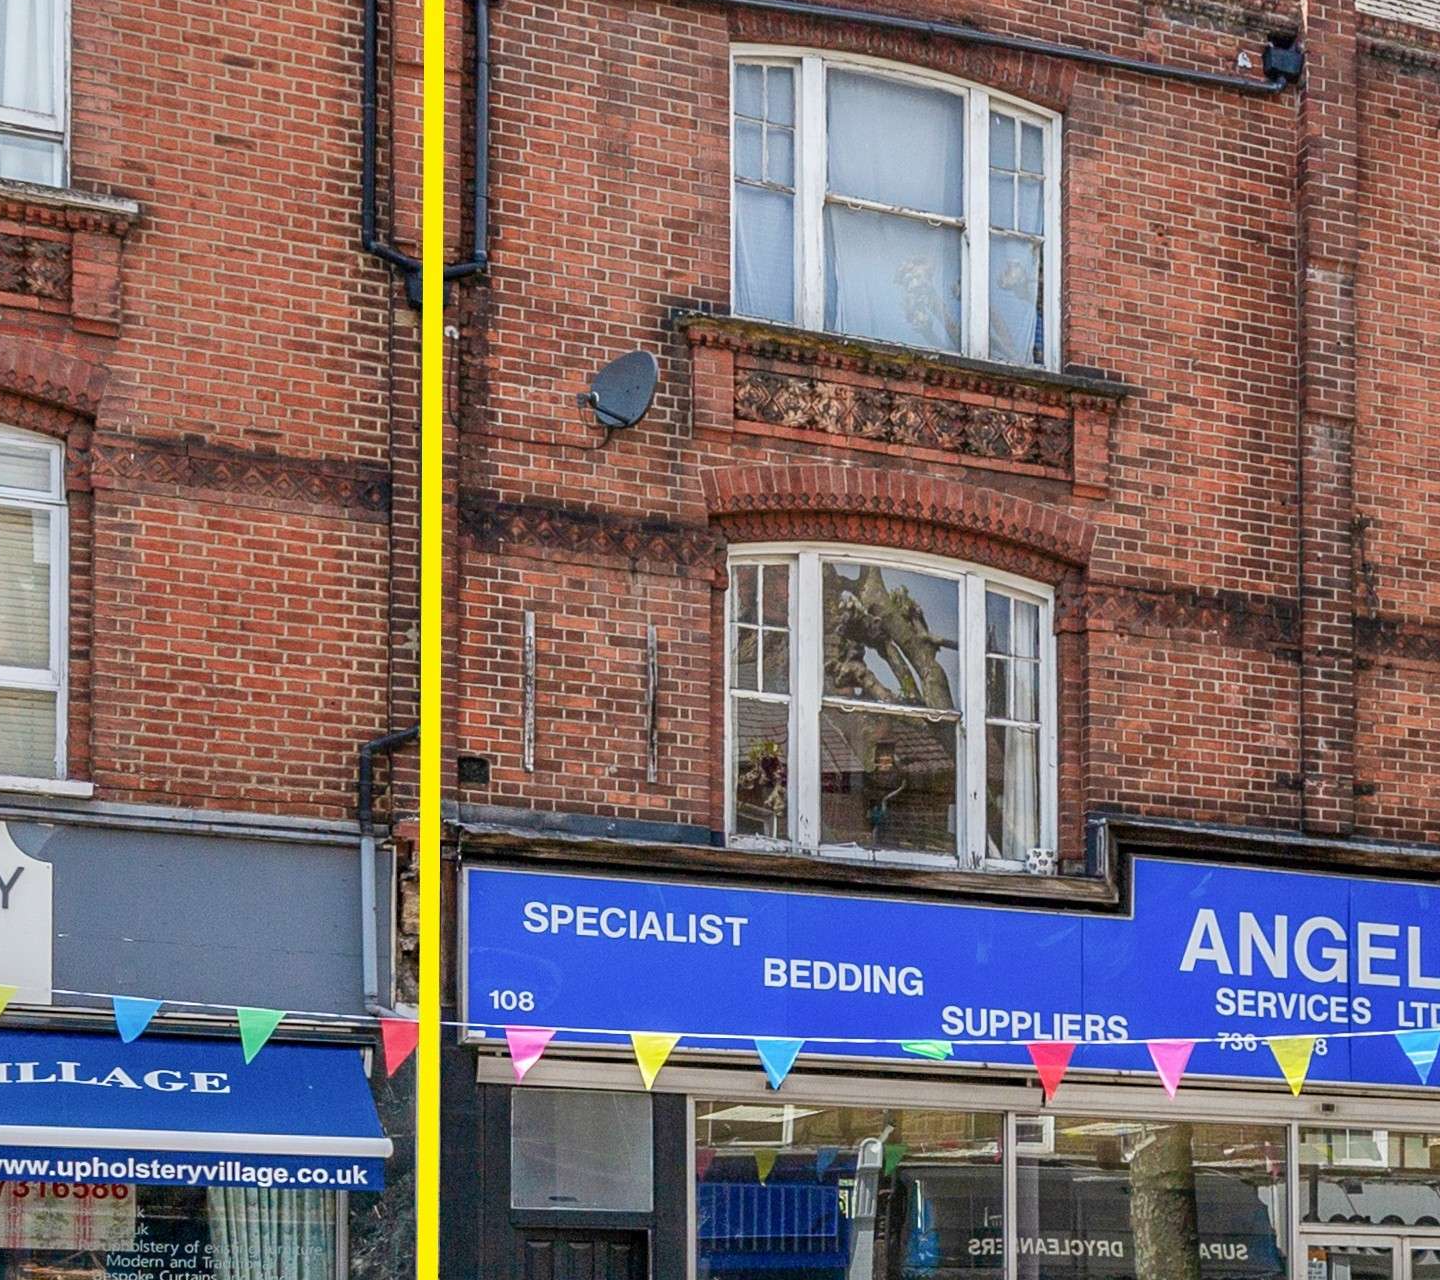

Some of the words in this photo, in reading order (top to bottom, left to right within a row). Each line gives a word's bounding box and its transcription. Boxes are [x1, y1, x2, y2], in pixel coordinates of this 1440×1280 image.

[522, 901, 749, 947] SPECIALIST
[763, 956, 925, 997] BEDDING
[489, 989, 536, 1013] 108
[1215, 987, 1372, 1025] SERVICES
[942, 1004, 1129, 1041] SUPPLIERS
[106, 1254, 164, 1269] Modern
[169, 1255, 197, 1269] and
[185, 1240, 200, 1254] of
